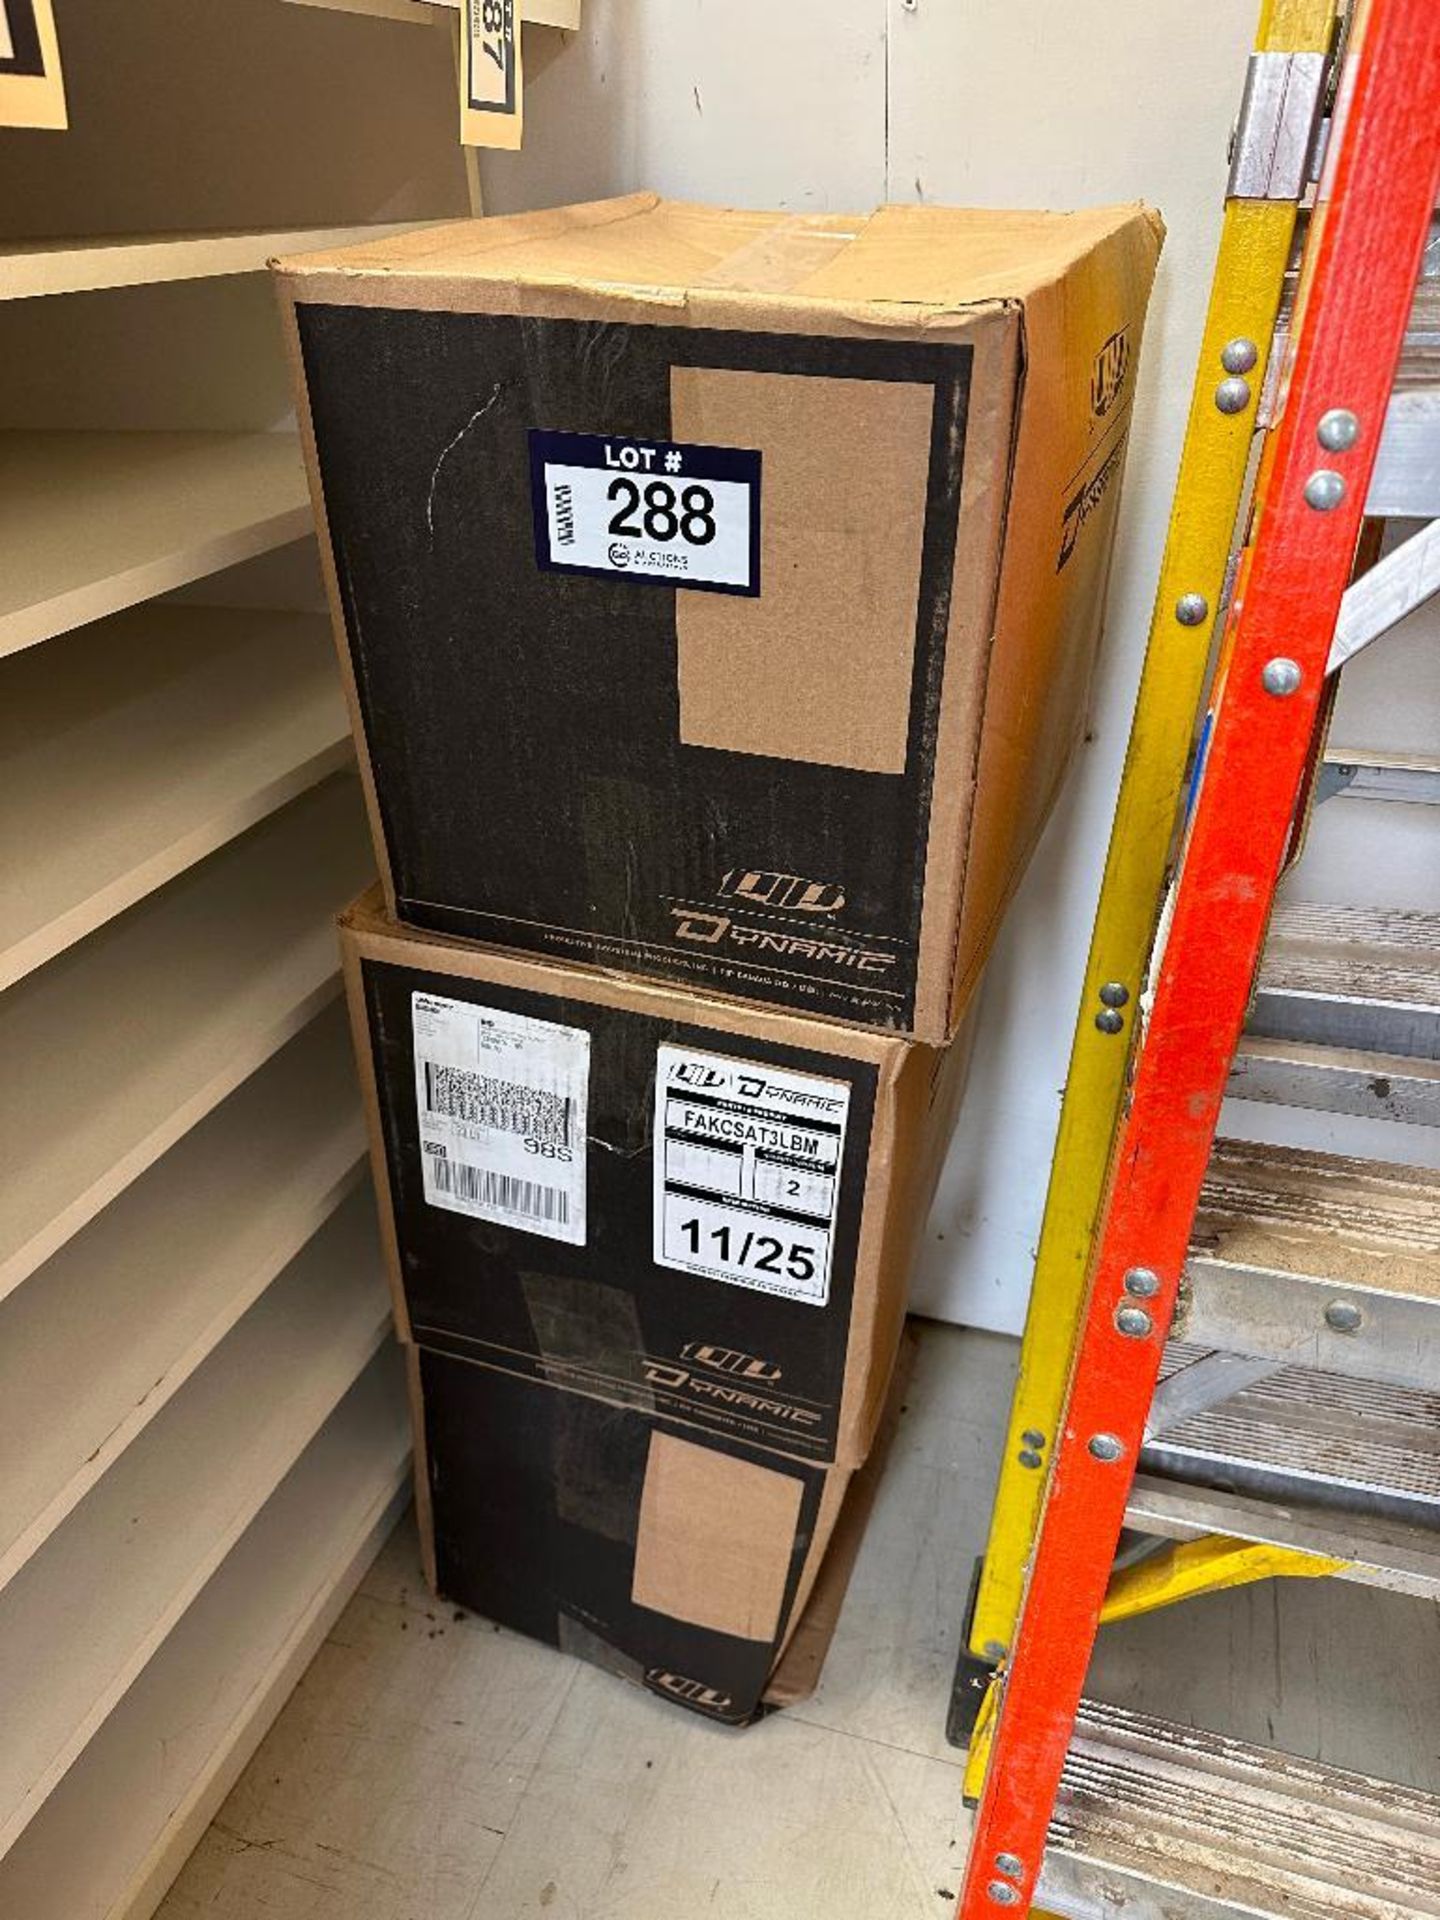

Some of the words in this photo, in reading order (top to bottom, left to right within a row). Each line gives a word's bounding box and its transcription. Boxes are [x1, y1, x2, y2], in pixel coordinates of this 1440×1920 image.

[604, 444, 656, 468] LOT
[664, 451, 683, 473] #
[607, 477, 716, 546] 288
[669, 906, 896, 974] DYNAMIC
[737, 1074, 846, 1114] DYNAMIC
[684, 1110, 820, 1156] FAKCSAT3LBM
[787, 1180, 801, 1196] 2
[681, 1218, 816, 1282] 11/25
[641, 1359, 822, 1426] DYNAMIC
